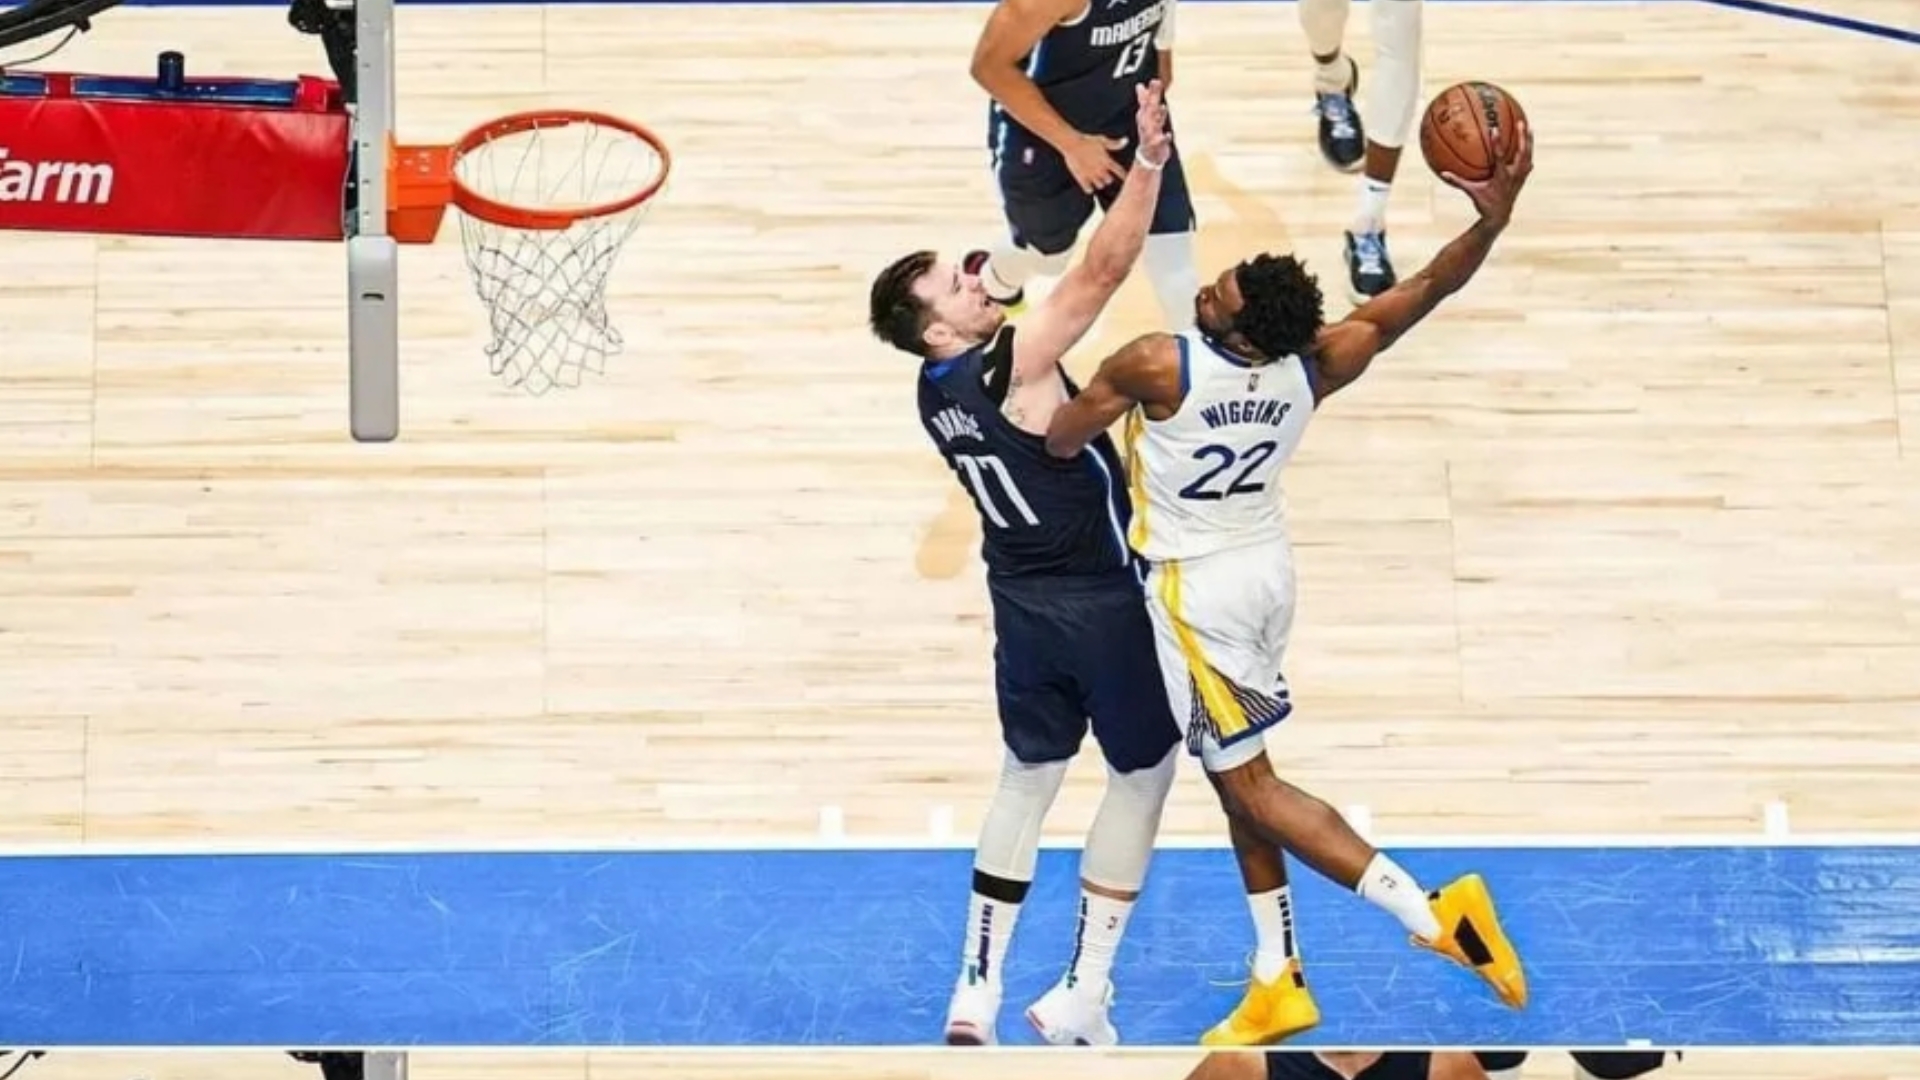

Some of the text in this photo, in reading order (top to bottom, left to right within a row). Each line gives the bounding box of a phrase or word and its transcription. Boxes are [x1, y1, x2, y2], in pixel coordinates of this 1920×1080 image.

[1113, 31, 1151, 78] 13
[0, 147, 114, 204] arm
[1200, 400, 1291, 429] WIGGINS
[953, 454, 1040, 528] 77
[1178, 440, 1277, 500] 22
